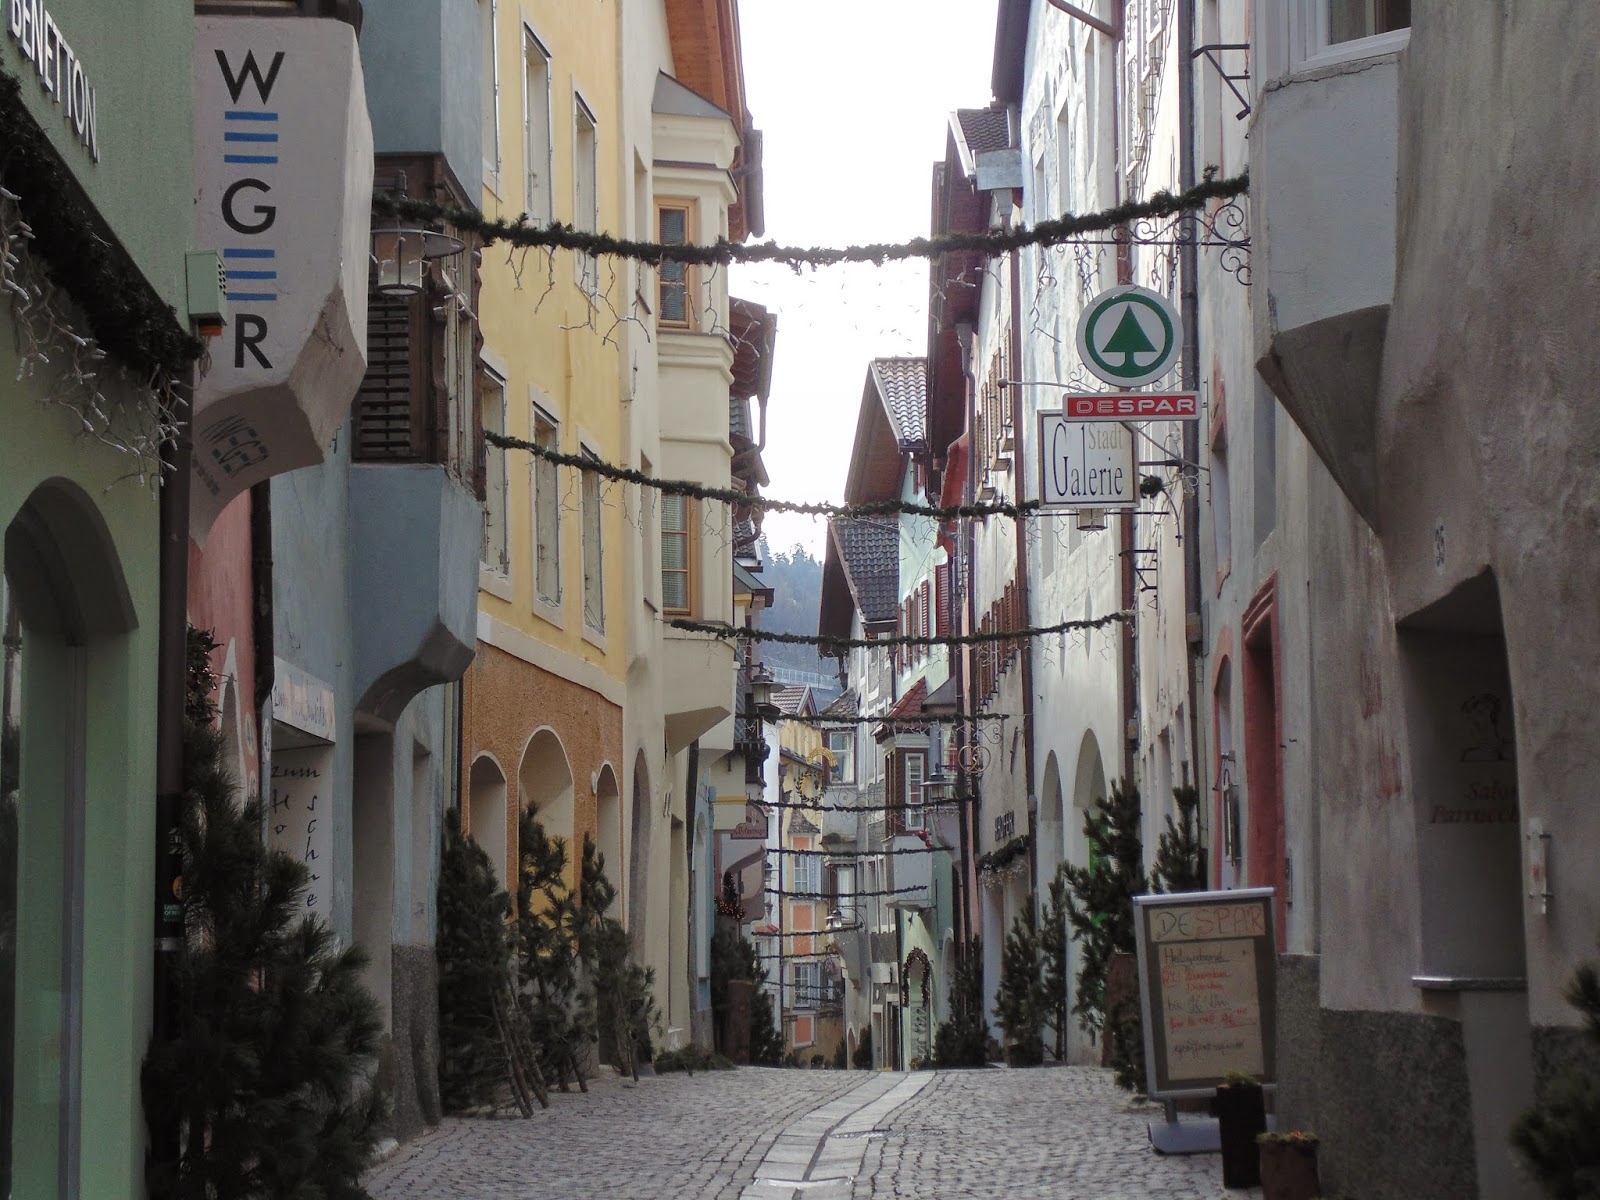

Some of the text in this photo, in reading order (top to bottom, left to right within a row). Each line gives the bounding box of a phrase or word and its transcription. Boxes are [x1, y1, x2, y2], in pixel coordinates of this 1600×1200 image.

[1076, 398, 1195, 414] DESPAR
[1088, 421, 1124, 450] Stadt
[1052, 422, 1124, 497] Galerie
[1156, 905, 1265, 940] DESPAR
